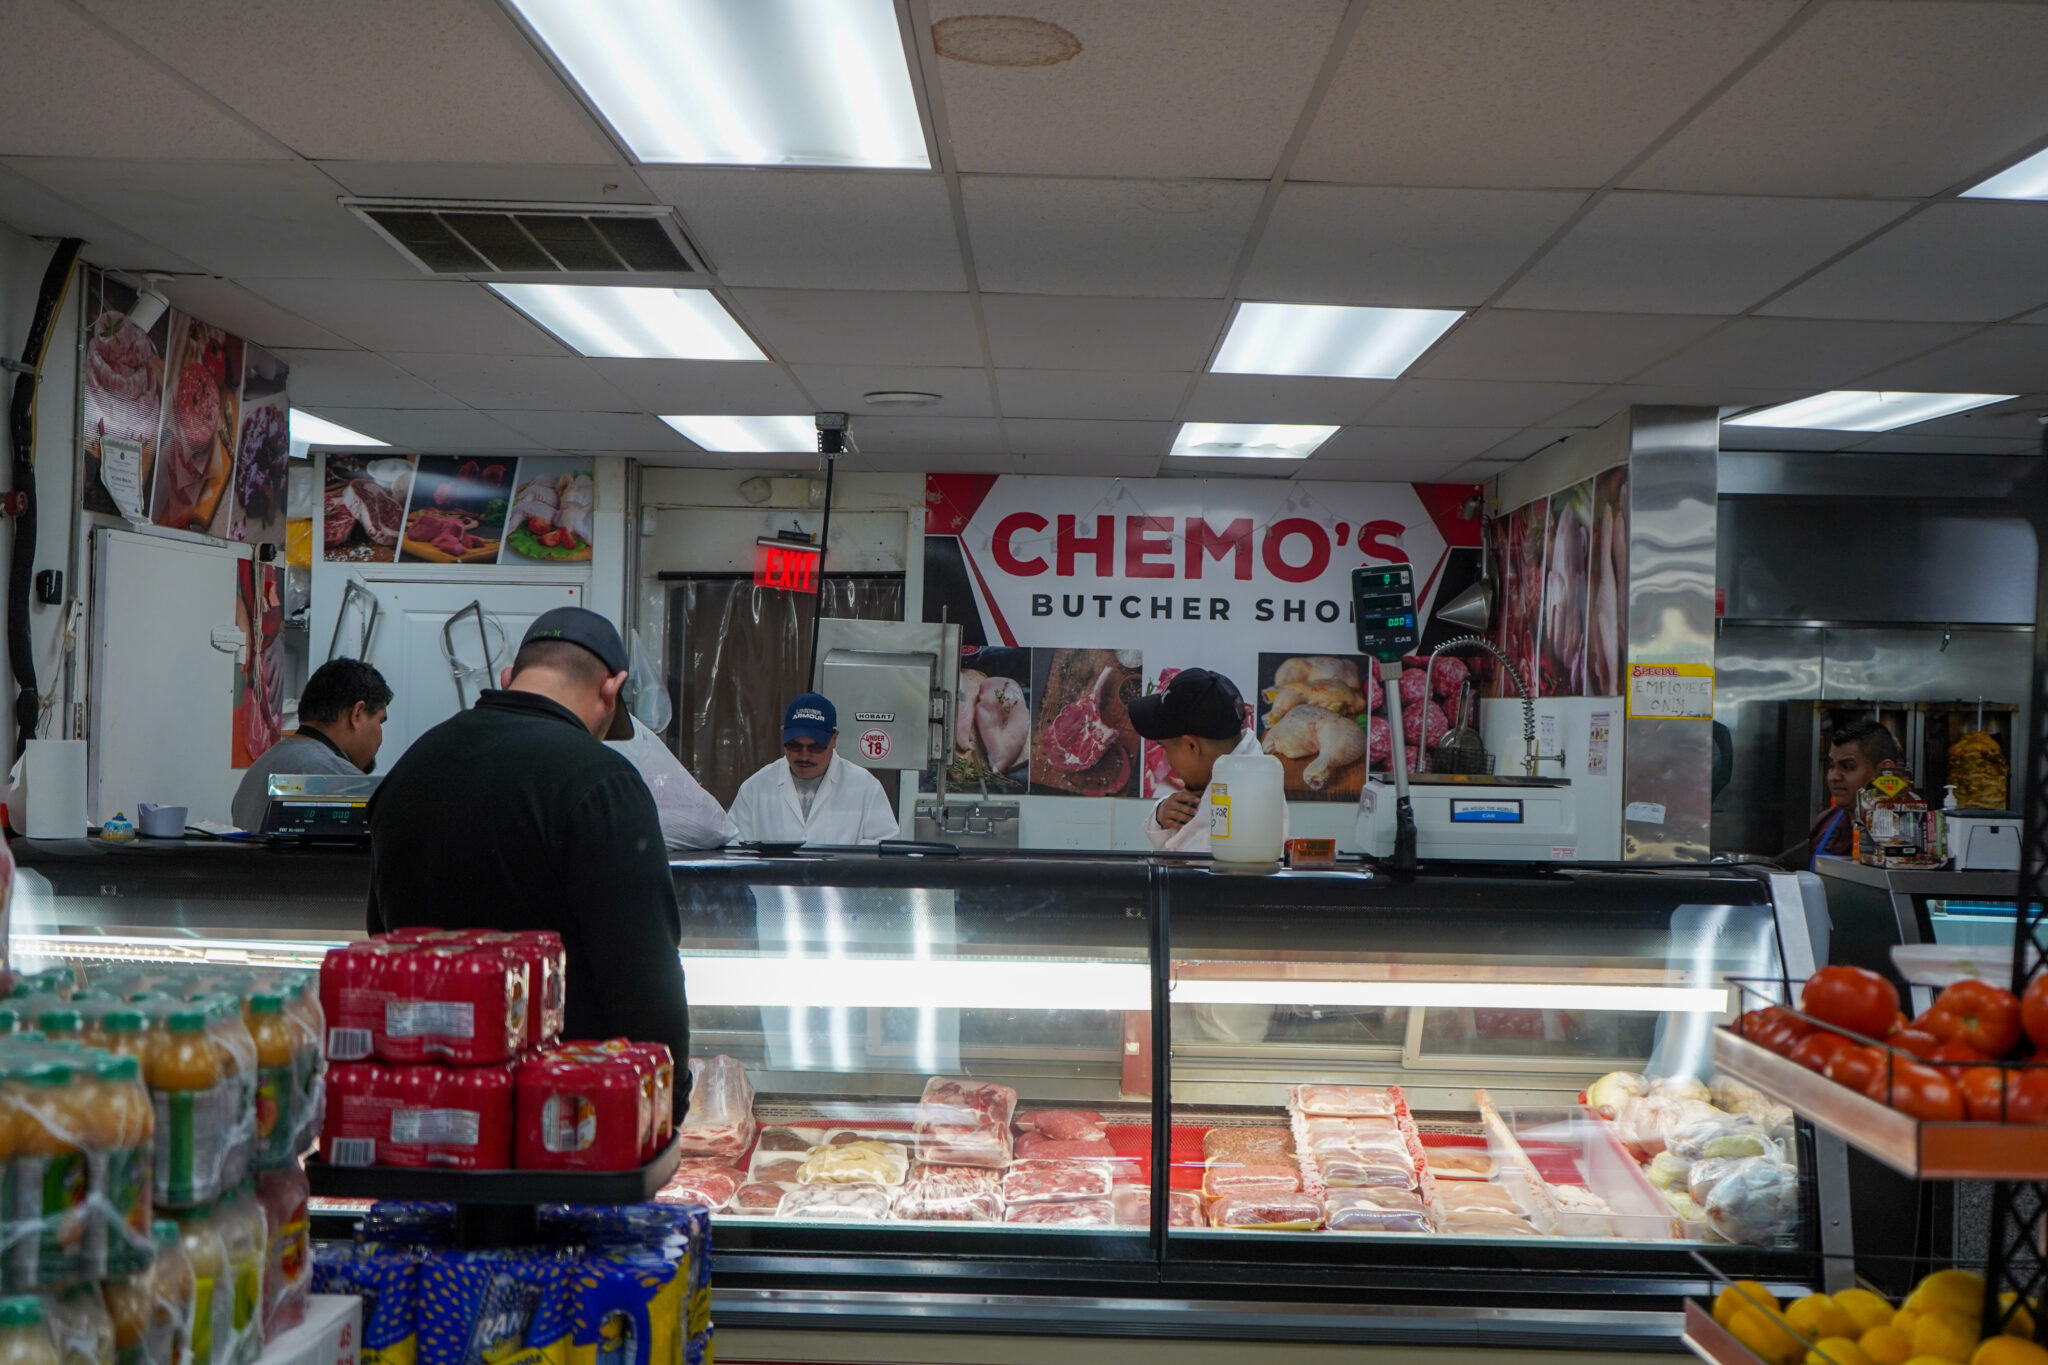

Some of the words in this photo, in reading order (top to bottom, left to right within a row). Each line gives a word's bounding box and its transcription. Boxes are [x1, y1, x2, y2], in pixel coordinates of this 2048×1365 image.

[991, 511, 1410, 584] CHEMO'S
[765, 548, 817, 590] EXIT
[1031, 593, 1231, 621] BUTCHER
[1255, 598, 1355, 624] SHO
[1635, 680, 1711, 696] EMPLOYEE
[792, 713, 825, 722] ARMOUR
[868, 742, 882, 755] 18
